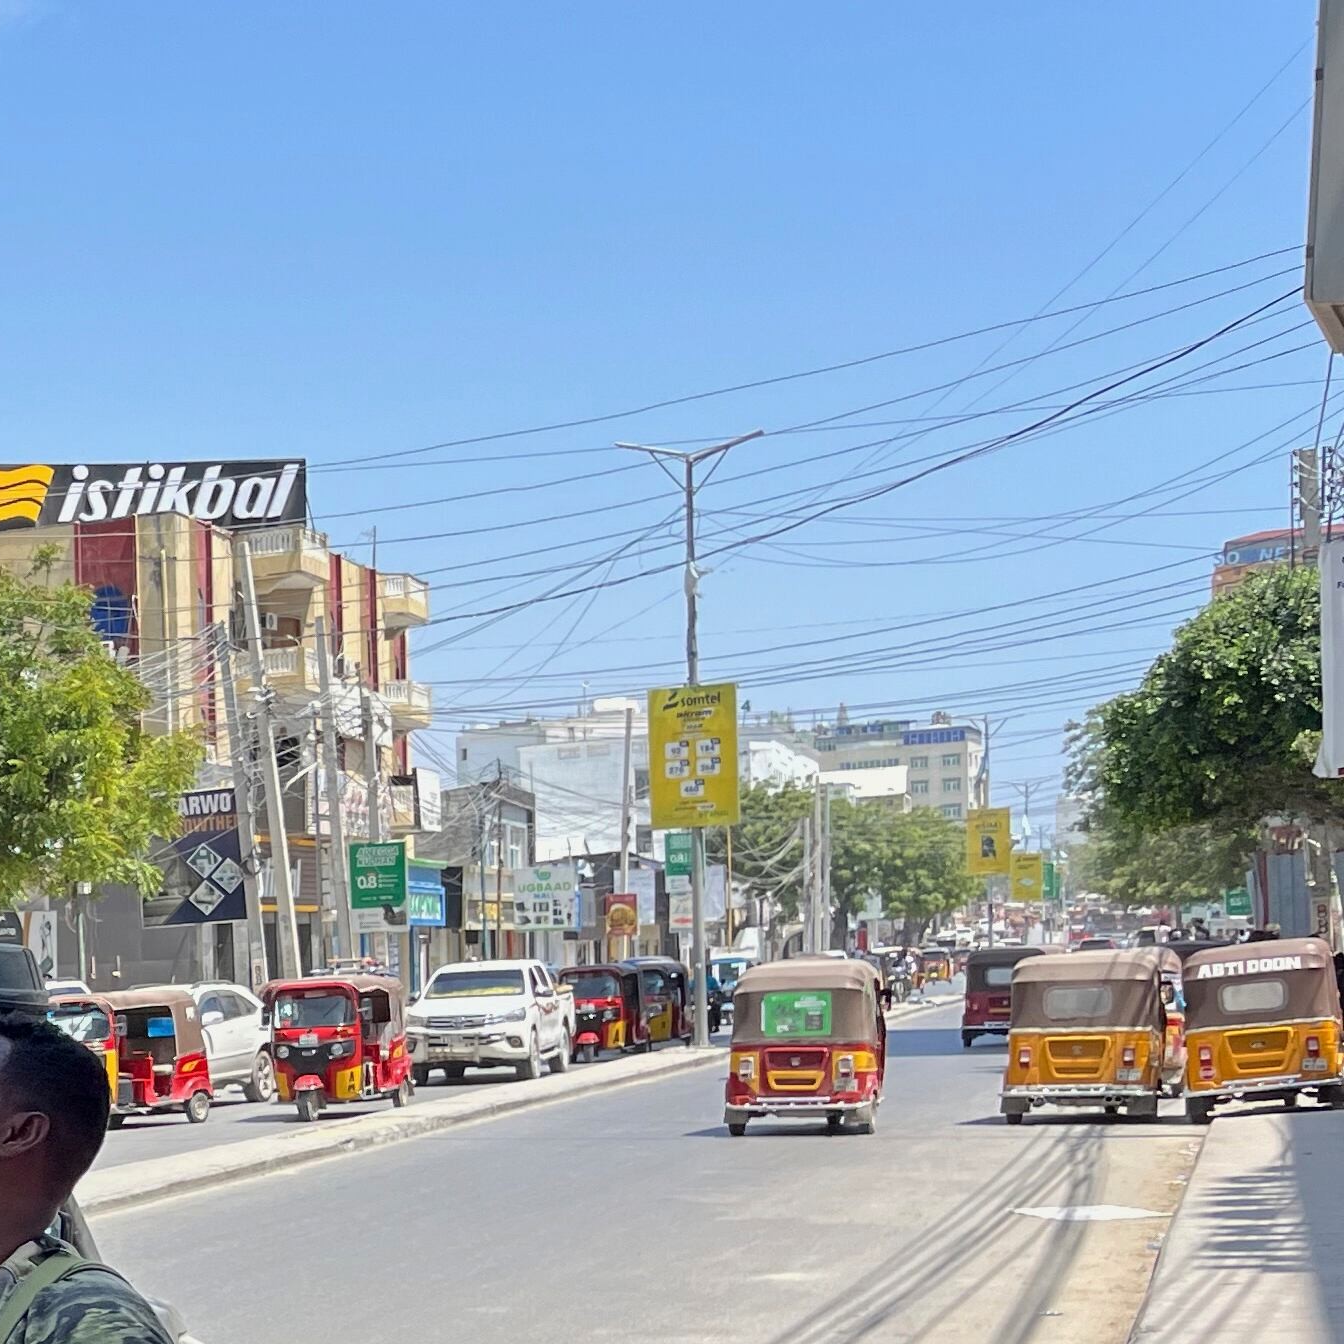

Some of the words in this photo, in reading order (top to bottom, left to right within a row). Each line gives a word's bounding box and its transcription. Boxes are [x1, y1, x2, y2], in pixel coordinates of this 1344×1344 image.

[57, 463, 300, 523] istikbal
[680, 691, 721, 708] somtel
[518, 882, 572, 893] UGBAAD
[1197, 960, 1245, 979] ABTI
[1246, 956, 1302, 975] DOON
